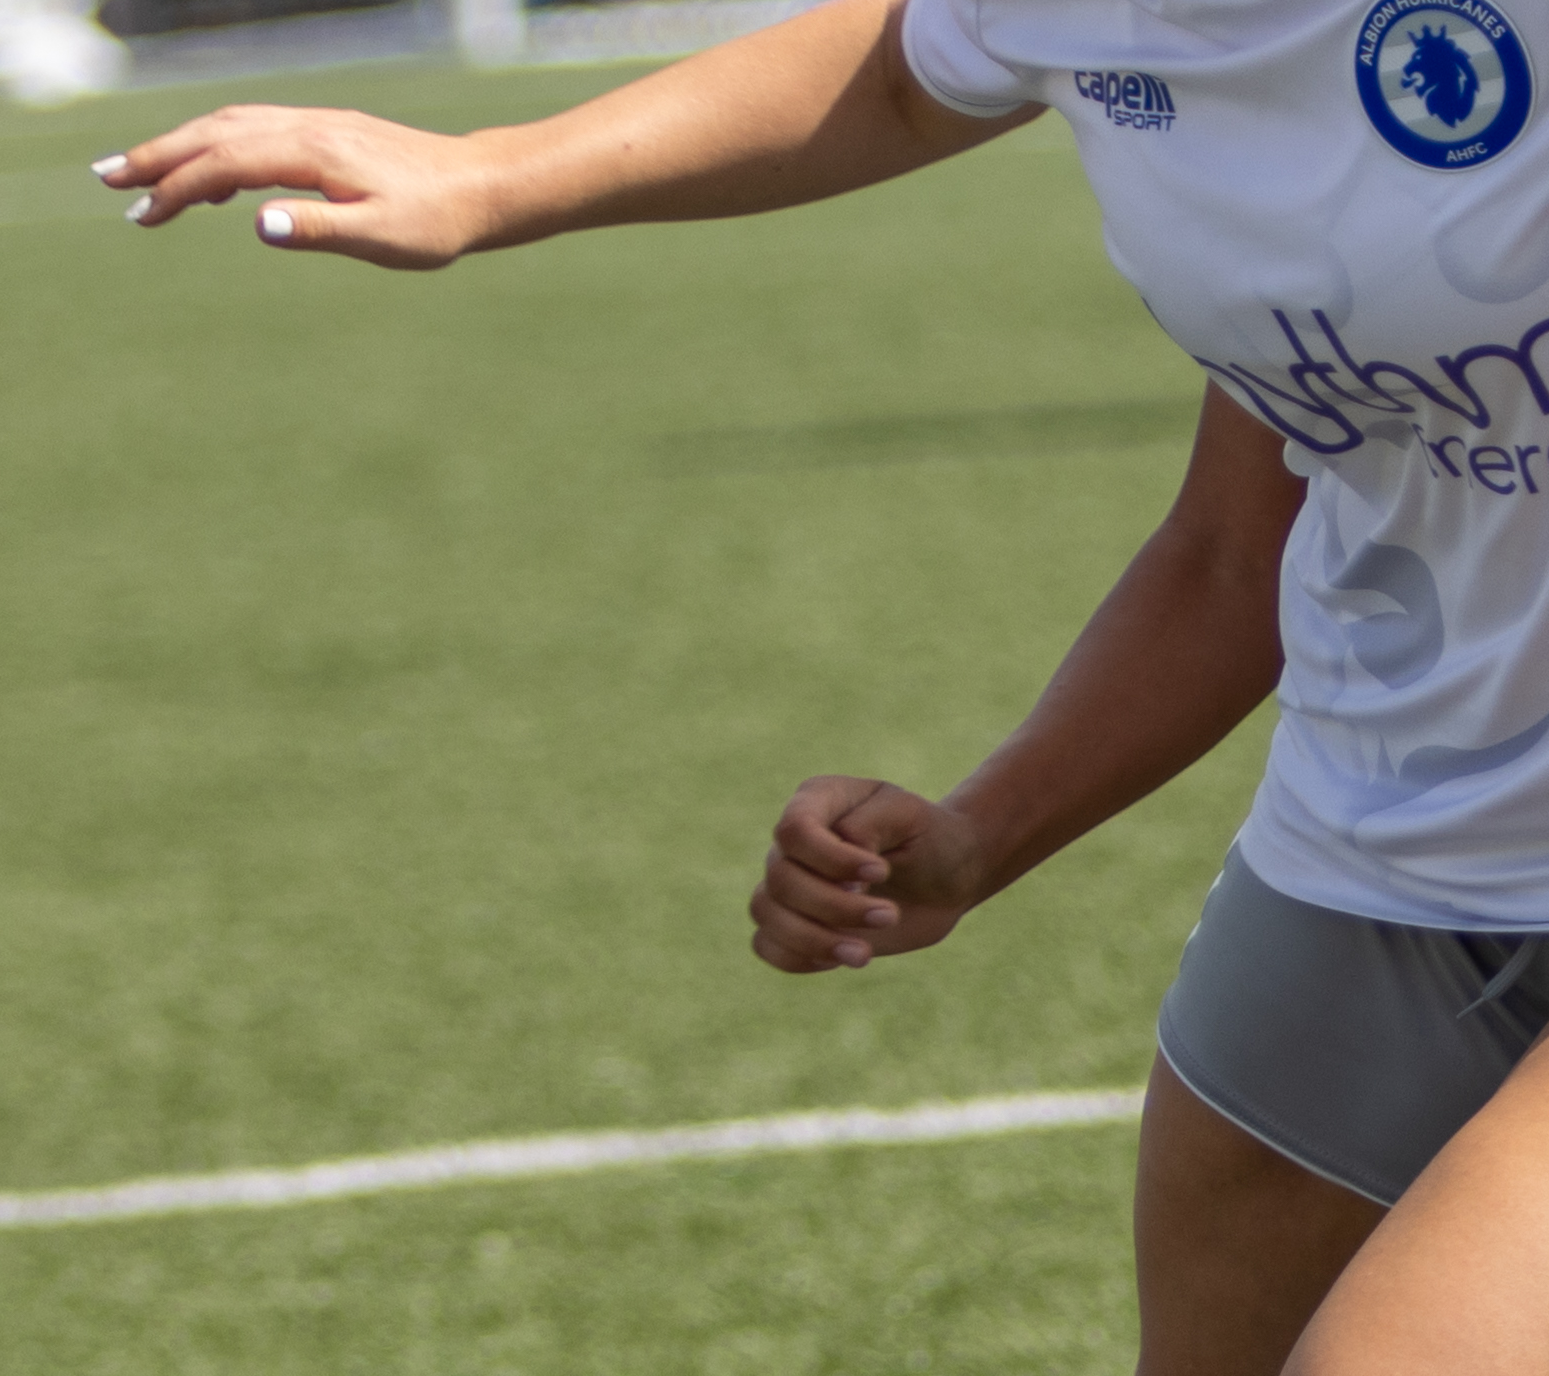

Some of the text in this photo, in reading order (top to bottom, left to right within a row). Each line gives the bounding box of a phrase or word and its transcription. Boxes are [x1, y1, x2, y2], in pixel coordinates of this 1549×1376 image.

[1359, 2, 1398, 67] ALBION
[1074, 70, 1177, 119] capelli
[1113, 109, 1177, 132] SPORT
[1445, 141, 1488, 163] AHFC
